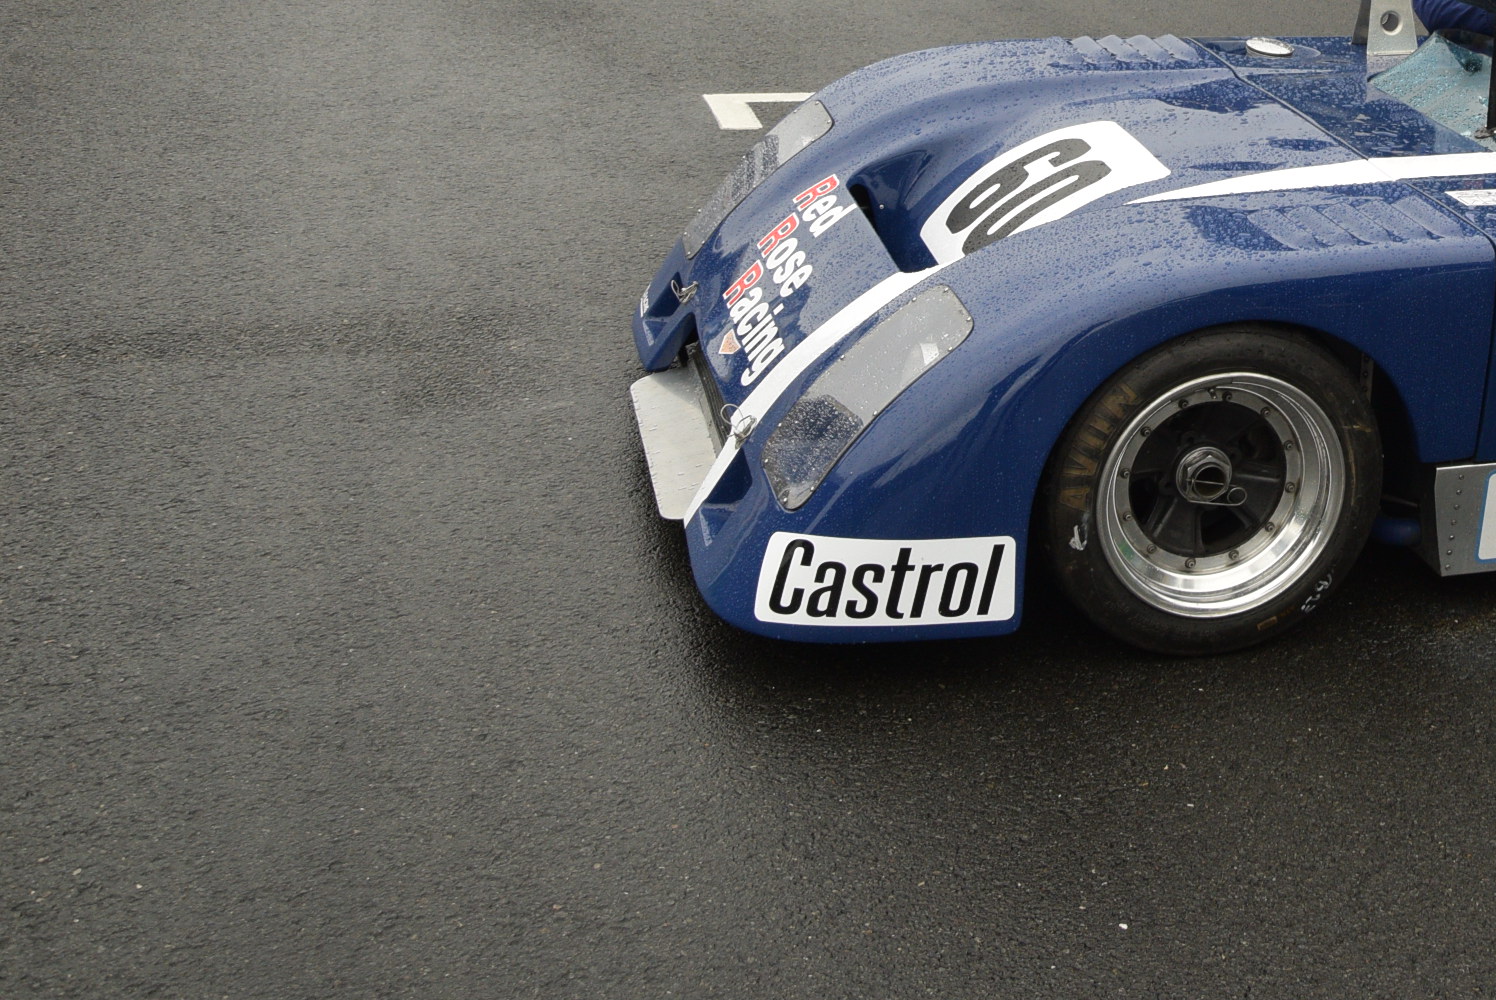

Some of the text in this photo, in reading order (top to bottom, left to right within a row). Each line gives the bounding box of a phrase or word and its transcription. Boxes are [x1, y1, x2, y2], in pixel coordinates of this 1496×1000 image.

[792, 173, 857, 238] Red
[945, 138, 1112, 257] 60
[757, 212, 813, 298] Rose
[723, 262, 787, 387] Racing
[1059, 383, 1139, 512] AVON
[768, 539, 1006, 621] Castrol
